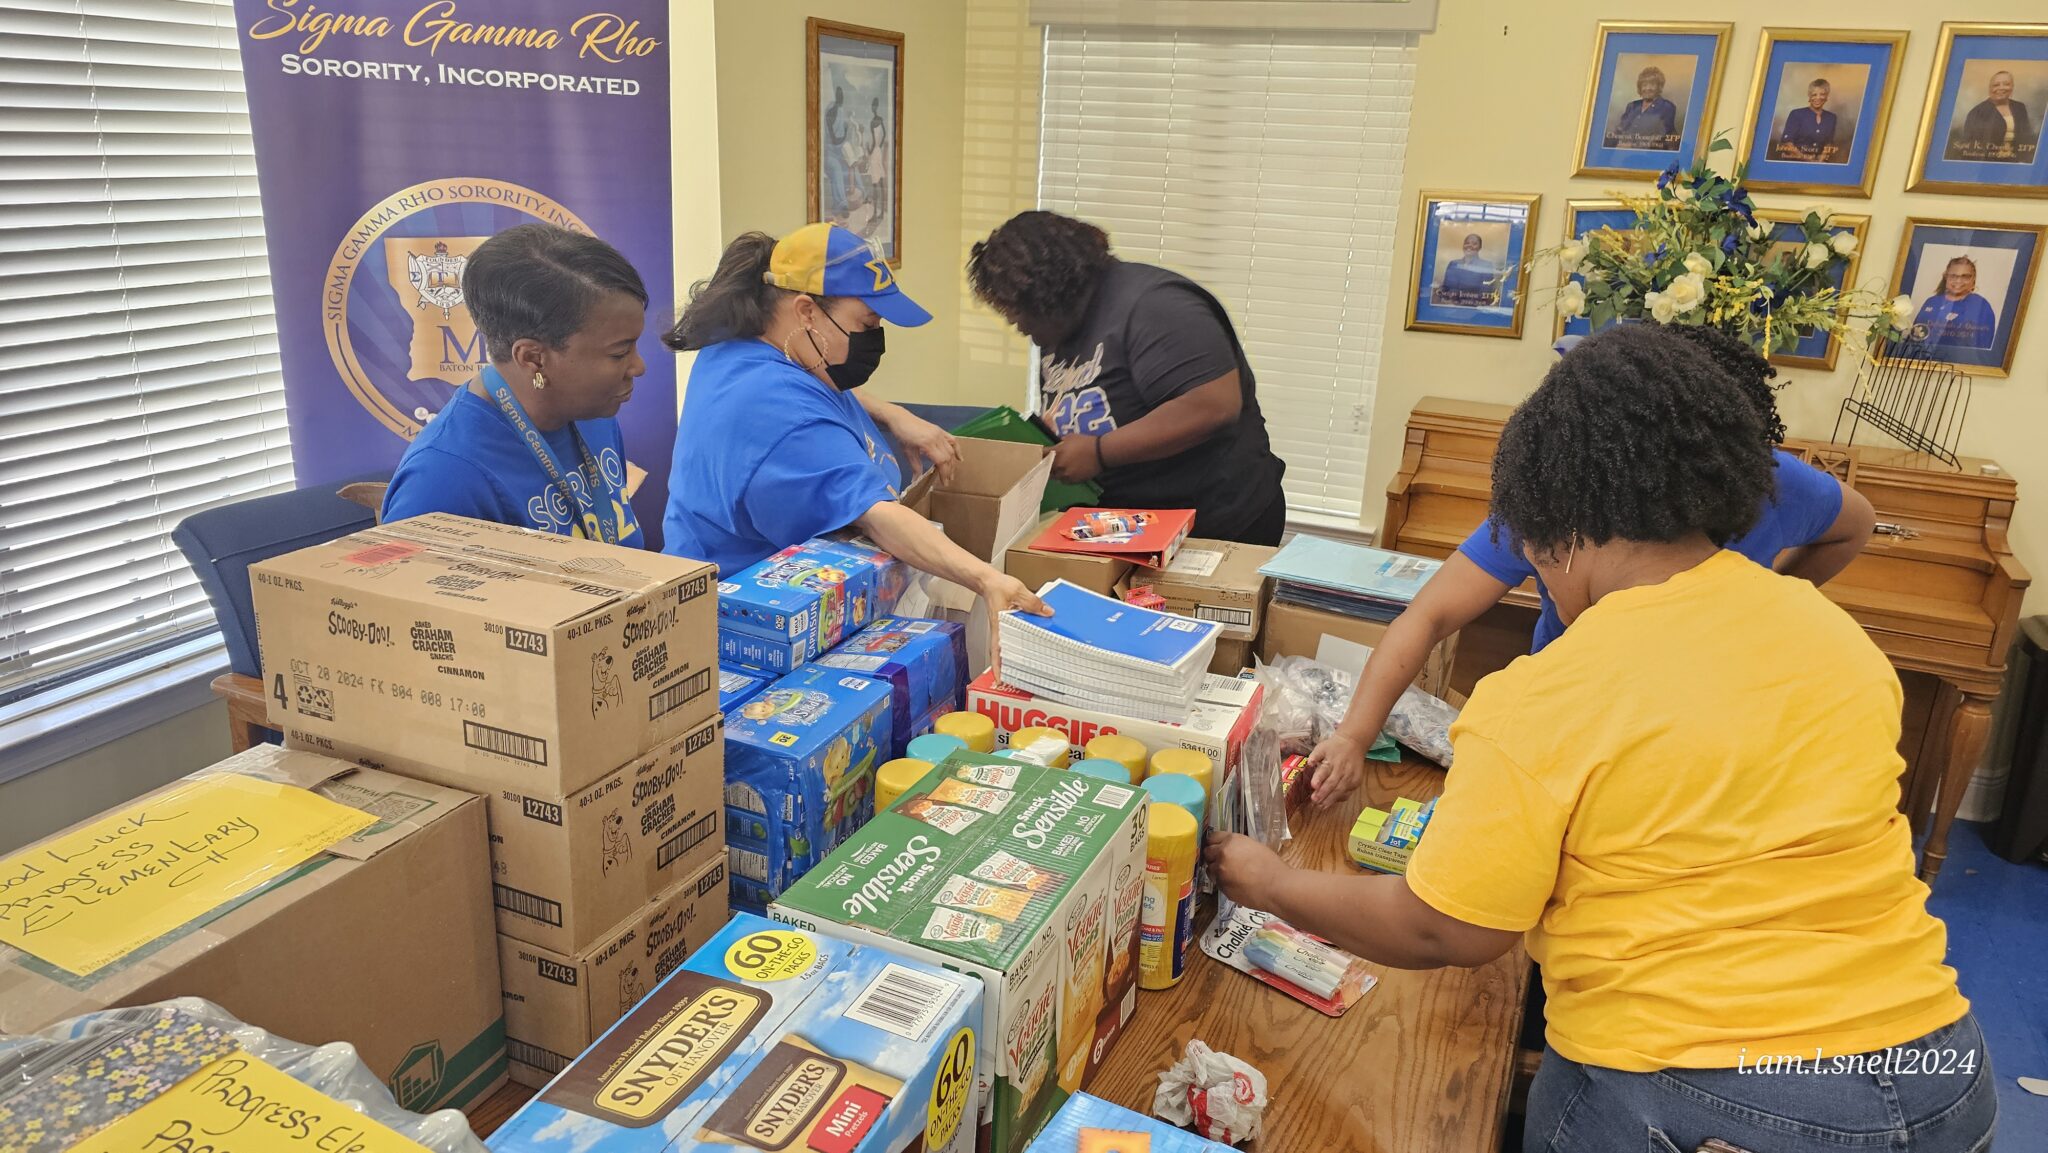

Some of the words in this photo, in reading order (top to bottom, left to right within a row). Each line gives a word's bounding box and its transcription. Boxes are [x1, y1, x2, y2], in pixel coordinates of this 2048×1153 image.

[249, 0, 395, 54] Sigma
[404, 0, 564, 57] Gamma
[569, 12, 661, 63] Rho
[438, 63, 640, 97] INCORPORATED
[327, 265, 352, 321] SIGMA
[342, 206, 399, 261] GAMMA
[398, 186, 445, 213] RHO
[495, 387, 528, 432] Sigma
[525, 430, 559, 479] Gamma
[404, 520, 479, 538] FRAGILE
[680, 577, 707, 602] 12743
[410, 627, 453, 641] GRAHAM
[412, 640, 456, 653] CRACKER
[507, 628, 545, 654] 12743
[430, 653, 454, 661] SNACKS
[632, 641, 667, 671] GRAHAM
[633, 652, 668, 682] CRACKER
[438, 665, 485, 680] CINNAMON
[653, 662, 689, 689] CINNAMON
[273, 673, 288, 710] 4
[687, 727, 713, 755] 12743
[525, 798, 561, 824] 12743
[641, 794, 675, 826] GRAHAM
[642, 803, 676, 836] CRACKER
[661, 809, 696, 840] CINNAMON
[1013, 778, 1090, 849] Sensible
[1017, 797, 1046, 822] Snack
[1075, 815, 1090, 827] NO
[1130, 804, 1147, 840] 30
[860, 843, 889, 865] BAKED
[1051, 835, 1075, 856] BAKED
[1130, 827, 1145, 853] BAGS
[699, 863, 724, 897] 12743
[835, 872, 855, 886] NO
[842, 835, 941, 916] Sensible
[896, 863, 935, 893] Snack
[953, 881, 976, 905] Veggie
[773, 913, 817, 933] BAKED
[943, 913, 965, 939] Veggie
[1042, 926, 1052, 942] NO
[655, 938, 686, 974] GRAHAM
[734, 935, 783, 969] 60
[1217, 925, 1253, 959] Chalkie
[540, 958, 575, 985] 12743
[756, 937, 804, 980] ON-THE-GO
[783, 951, 811, 974] PACKS
[815, 953, 829, 971] BAGS
[1009, 950, 1033, 986] BAKED
[611, 994, 738, 1106] SNYDER'S
[664, 1070, 684, 1087] OF
[683, 1022, 734, 1071] HANOVER
[937, 1033, 969, 1108] 60
[754, 1063, 826, 1138] SNYDER'S
[794, 1084, 825, 1117] HANOVER
[930, 1065, 972, 1137] ON-THE-GO
[825, 1100, 862, 1138] Mini
[844, 1110, 868, 1137] Pretzels
[939, 1105, 961, 1142] PACKS
